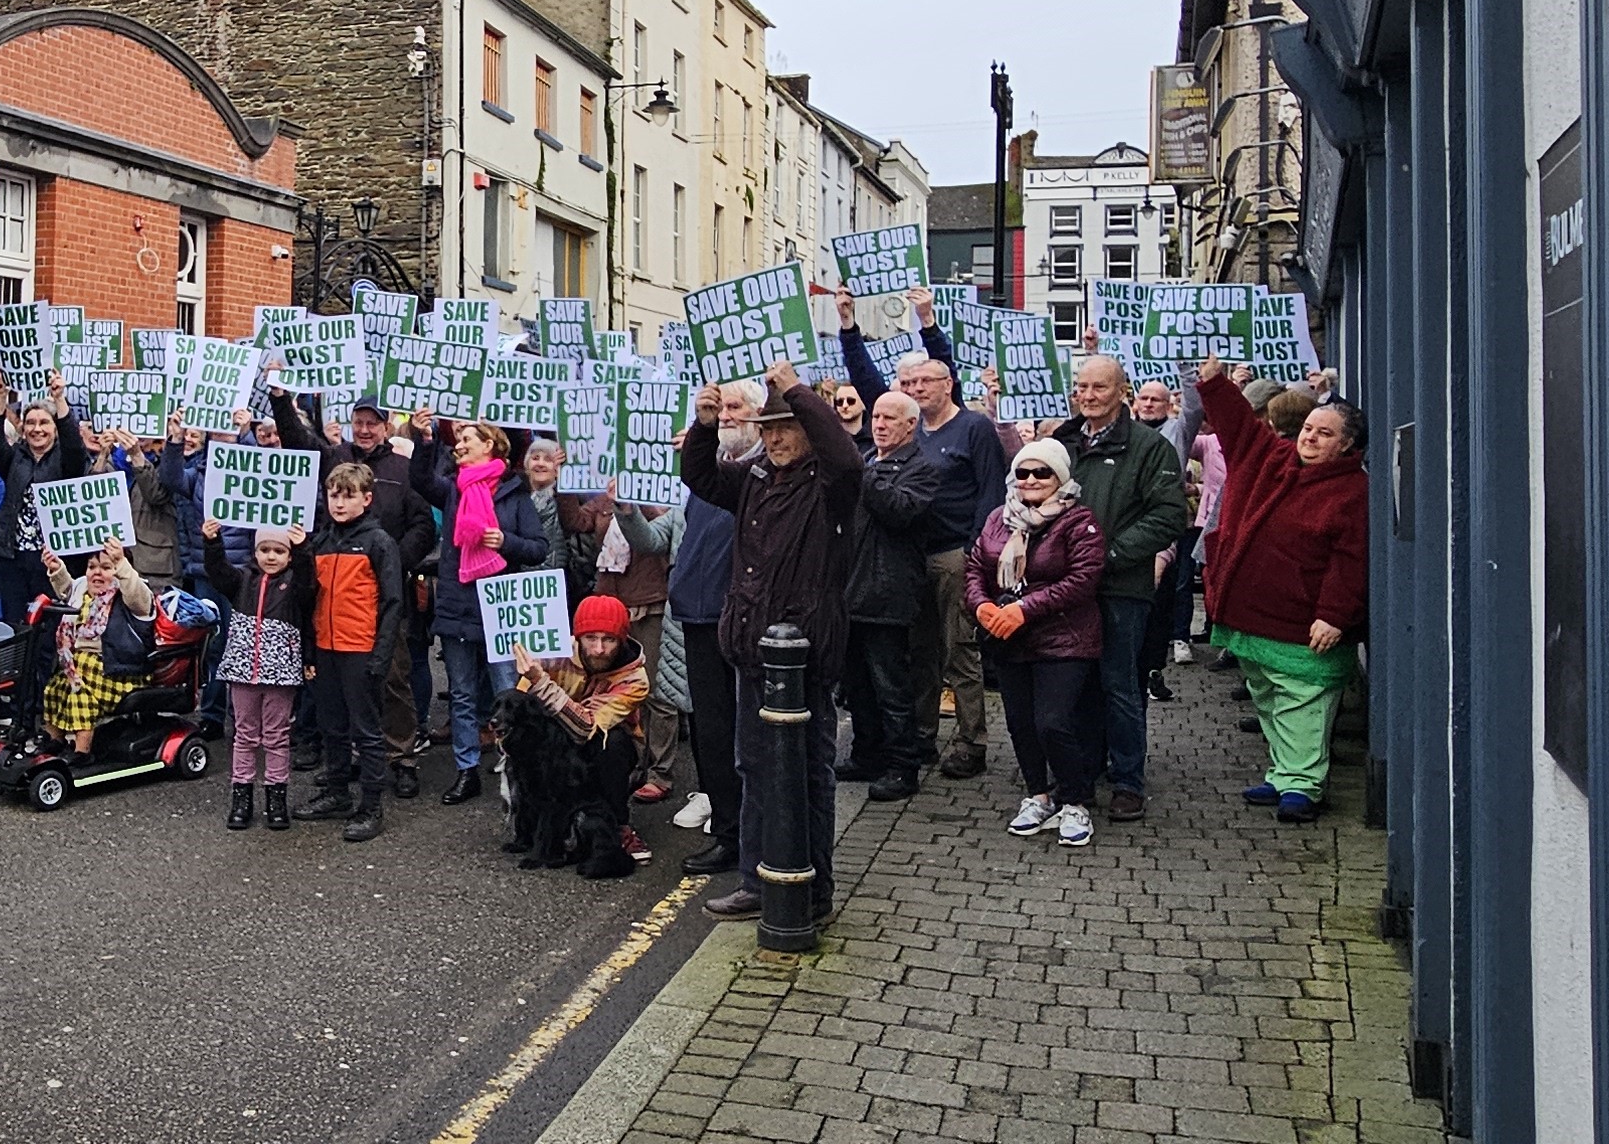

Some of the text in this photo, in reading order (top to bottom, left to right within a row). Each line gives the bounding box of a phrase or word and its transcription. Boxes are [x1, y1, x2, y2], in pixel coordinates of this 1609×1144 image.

[835, 226, 917, 257] SAVE OUR
[848, 248, 908, 276] POST
[846, 267, 921, 296] OFFICE
[1096, 281, 1130, 301] SAVE
[362, 292, 409, 317] SAVE
[687, 268, 798, 325] SAVE OUR
[1151, 287, 1196, 312] SAVE
[1200, 287, 1246, 311] OUR
[49, 308, 79, 326] OUR
[262, 308, 298, 323] SAVE
[443, 301, 489, 322] SAVE
[545, 300, 585, 322] SAVE
[954, 303, 989, 328] SAVE
[1159, 312, 1233, 335] POST
[94, 323, 119, 336] OUR
[273, 319, 356, 347] SAVE OUR
[364, 314, 402, 334] OUR
[445, 324, 484, 345] OUR
[550, 323, 584, 344] OUR
[703, 303, 784, 352] POST
[1000, 319, 1046, 344] SAVE
[1255, 320, 1293, 340] OUR
[0, 328, 38, 348] OUR
[887, 335, 912, 356] OUR
[1149, 336, 1245, 359] OFFICE
[1, 348, 43, 369] POST
[60, 346, 102, 366] SAVE
[203, 342, 251, 367] SAVE
[284, 344, 345, 366] POST
[390, 338, 482, 371] SAVE OUR
[547, 344, 590, 359] POST
[701, 331, 808, 384] OFFICE
[1005, 344, 1046, 370] OUR
[0, 368, 52, 391] OFFICE
[91, 373, 163, 393] SAVE OUR
[202, 364, 241, 386] OUR
[278, 365, 356, 388] OFFICE
[397, 362, 467, 392] POST
[487, 359, 569, 382] SAVE OUR
[1004, 370, 1052, 394] POST
[1252, 362, 1309, 382] OFFICE
[97, 393, 152, 414] POST
[194, 384, 241, 408] POST
[386, 384, 473, 418] OFFICE
[495, 382, 557, 402] POST
[625, 384, 680, 413] SAVE
[1000, 394, 1068, 419] OFFICE
[93, 413, 159, 435] OFFICE
[627, 412, 672, 443] OUR
[213, 447, 312, 478] SAVE OUR
[625, 442, 674, 473] POST
[39, 478, 121, 507] SAVE OUR
[223, 473, 297, 502] POST
[618, 470, 681, 505] OFFICE
[51, 501, 111, 529] POST
[211, 497, 305, 527] OFFICE
[49, 522, 126, 552] OFFICE
[484, 576, 557, 605] SAVE OUR
[497, 603, 547, 630] POST
[494, 628, 561, 656] OFFICE
